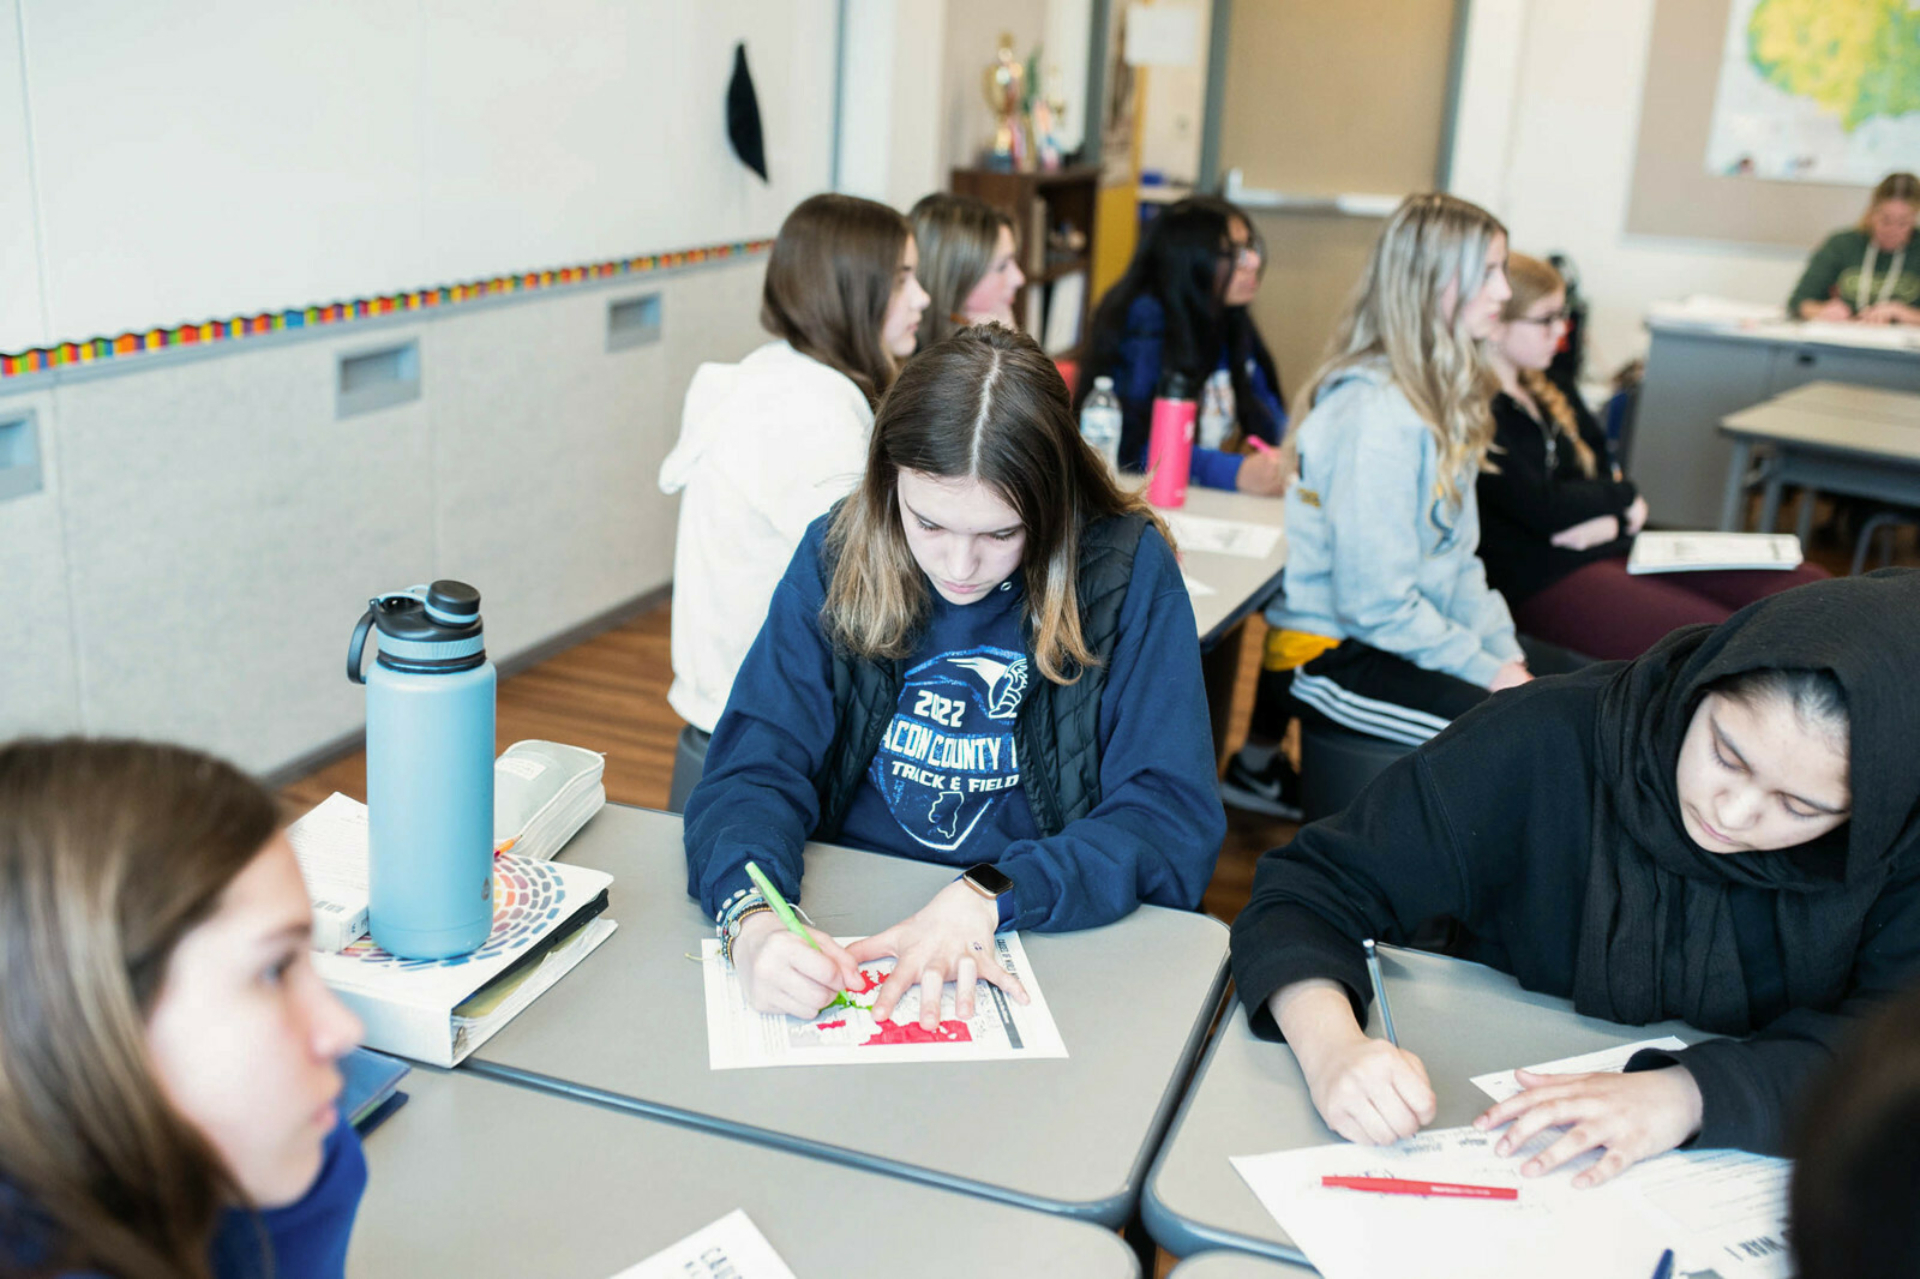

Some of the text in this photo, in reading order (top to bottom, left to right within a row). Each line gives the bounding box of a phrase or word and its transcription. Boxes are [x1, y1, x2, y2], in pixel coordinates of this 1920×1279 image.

[913, 690, 966, 728] 2022
[927, 734, 1002, 770] COUNTY
[892, 761, 1020, 793] TRACK & FIELD
